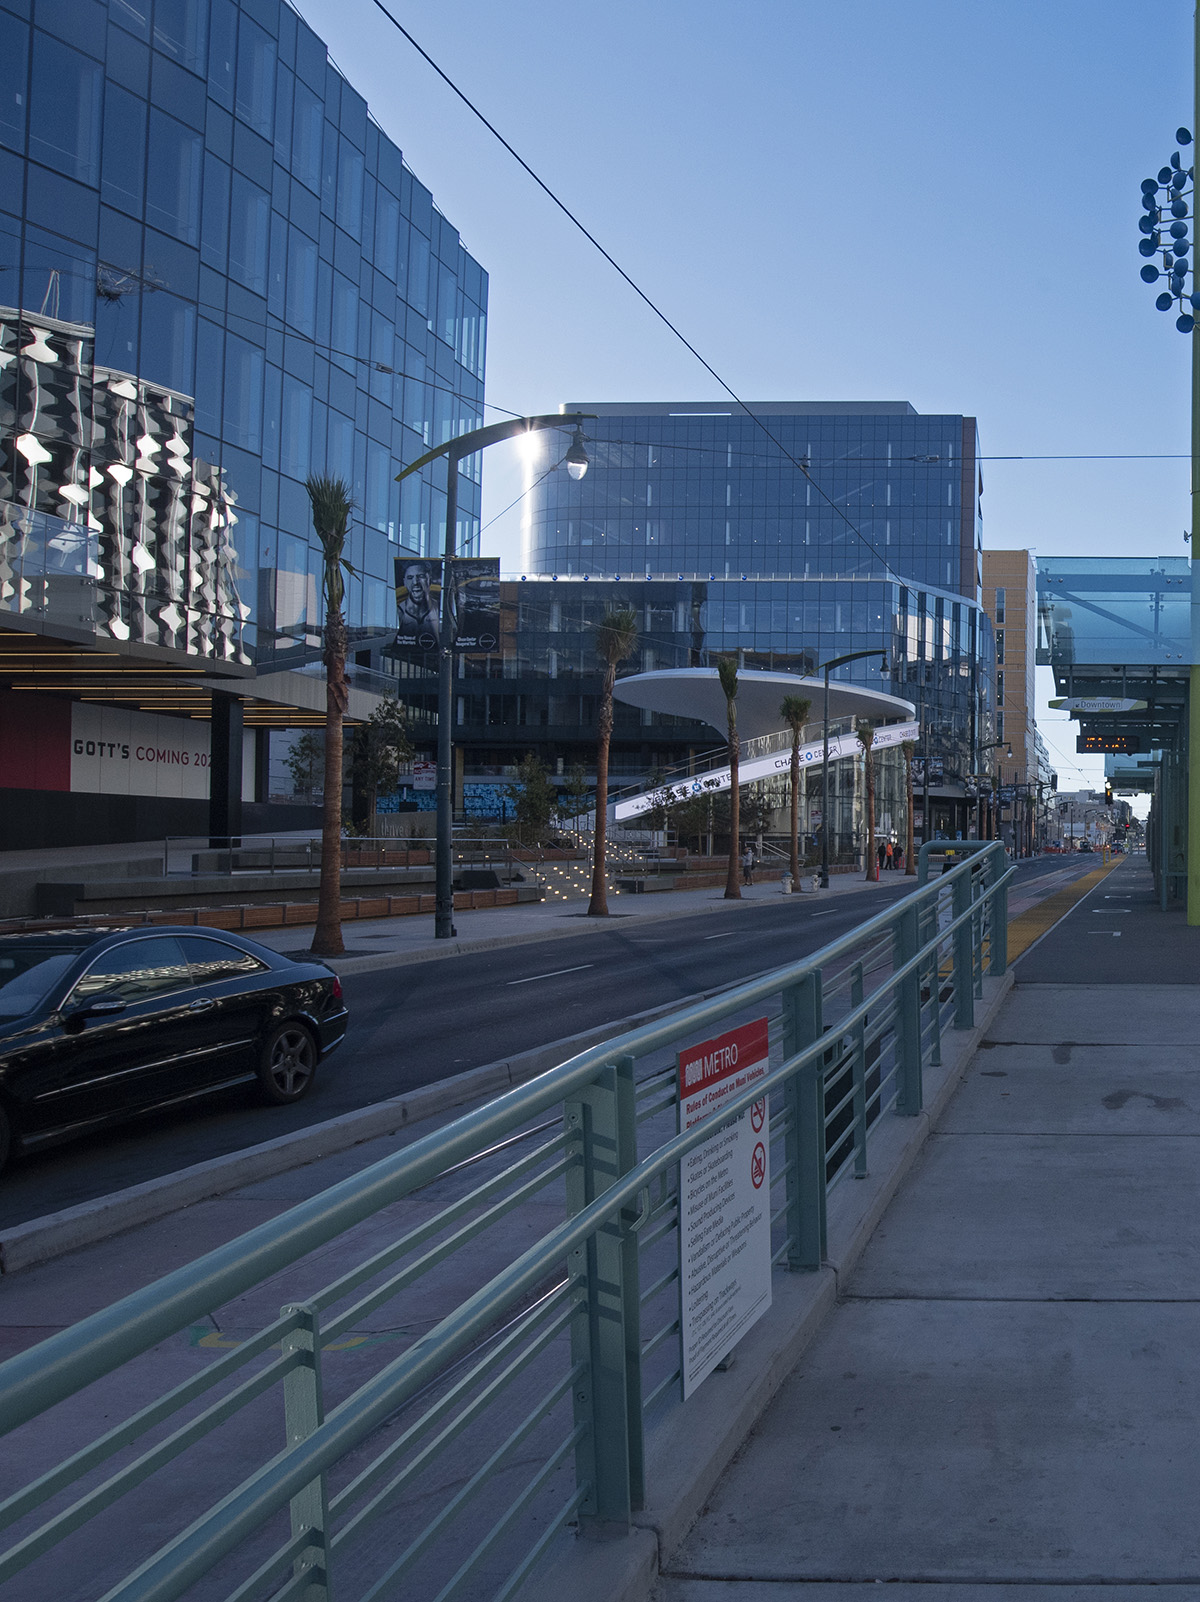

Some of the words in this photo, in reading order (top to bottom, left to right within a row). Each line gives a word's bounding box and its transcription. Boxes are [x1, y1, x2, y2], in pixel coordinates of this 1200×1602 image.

[74, 739, 130, 759] GOTT'S
[136, 746, 190, 765] COMING
[194, 752, 211, 767] 202
[775, 754, 805, 769] CHAE
[704, 1043, 738, 1079] METRO
[686, 1100, 702, 1115] Rules
[702, 1094, 708, 1106] of
[708, 1084, 729, 1103] Conduct
[729, 1082, 736, 1092] on
[736, 1073, 746, 1088] Muni
